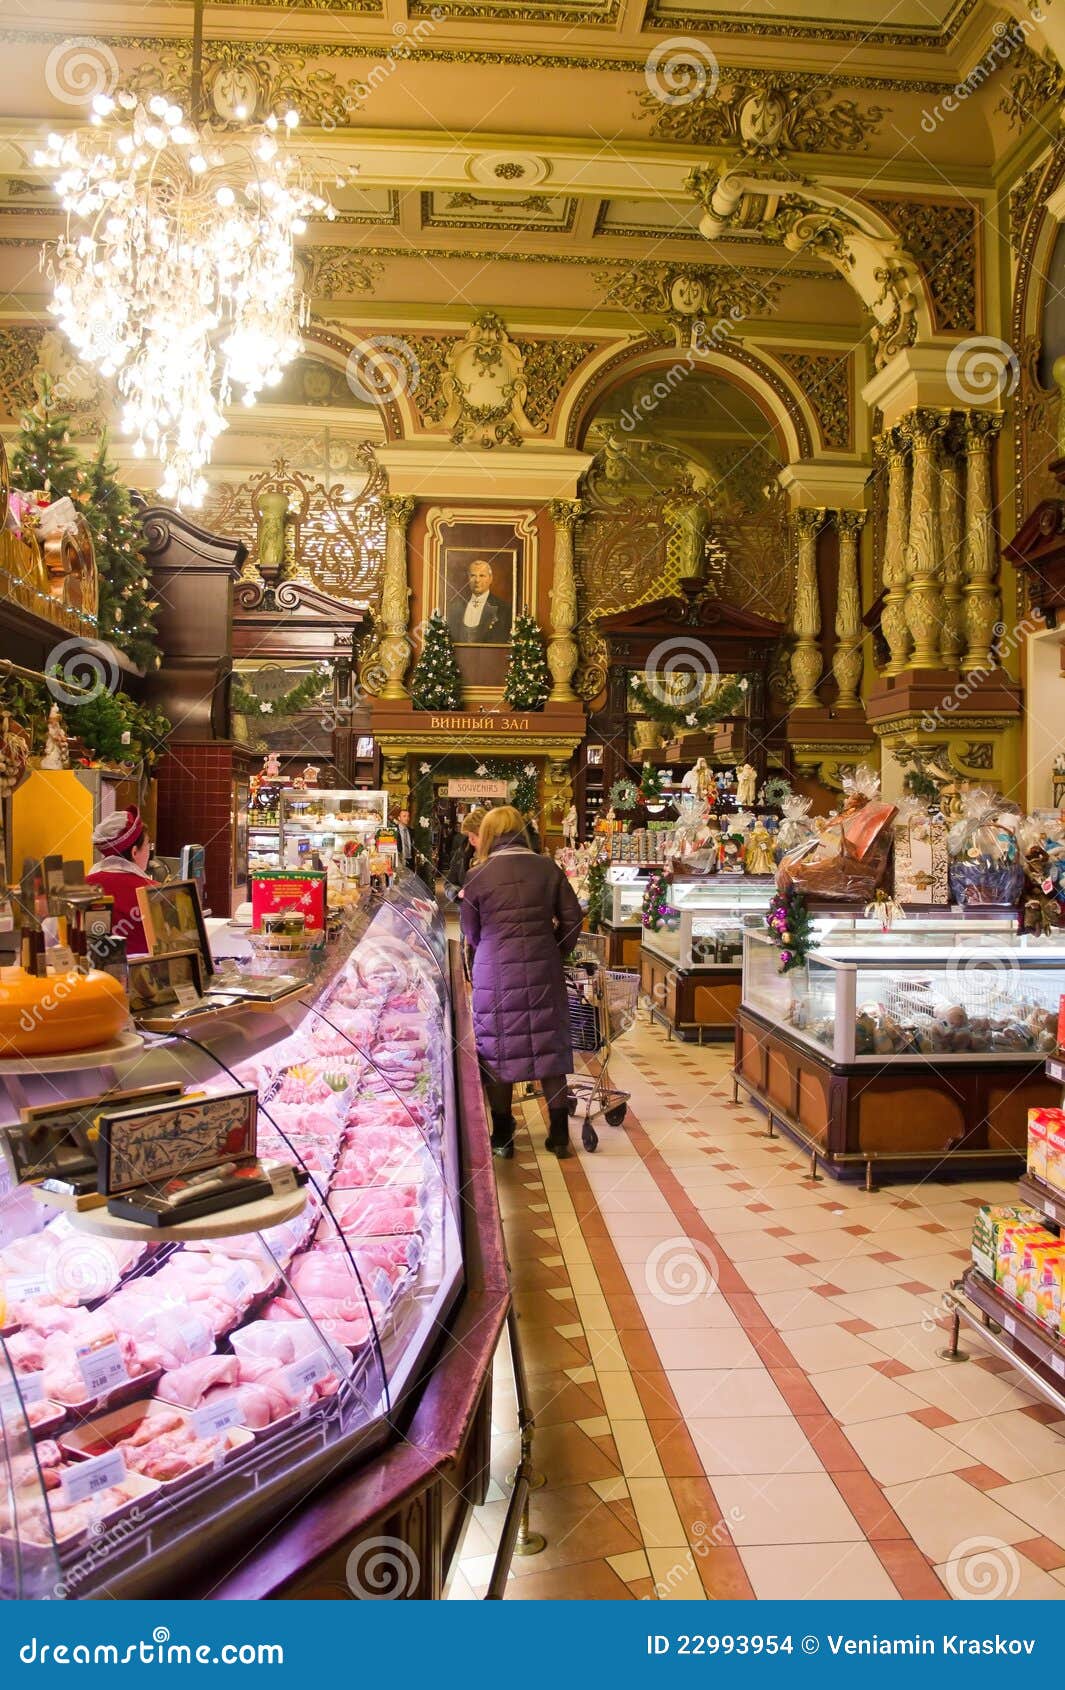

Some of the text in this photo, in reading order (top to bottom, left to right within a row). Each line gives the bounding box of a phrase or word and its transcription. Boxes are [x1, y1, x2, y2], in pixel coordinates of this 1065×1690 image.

[431, 715, 529, 730] ВИННЫЙ ЗАЛ
[457, 783, 498, 793] SOUVENIRS
